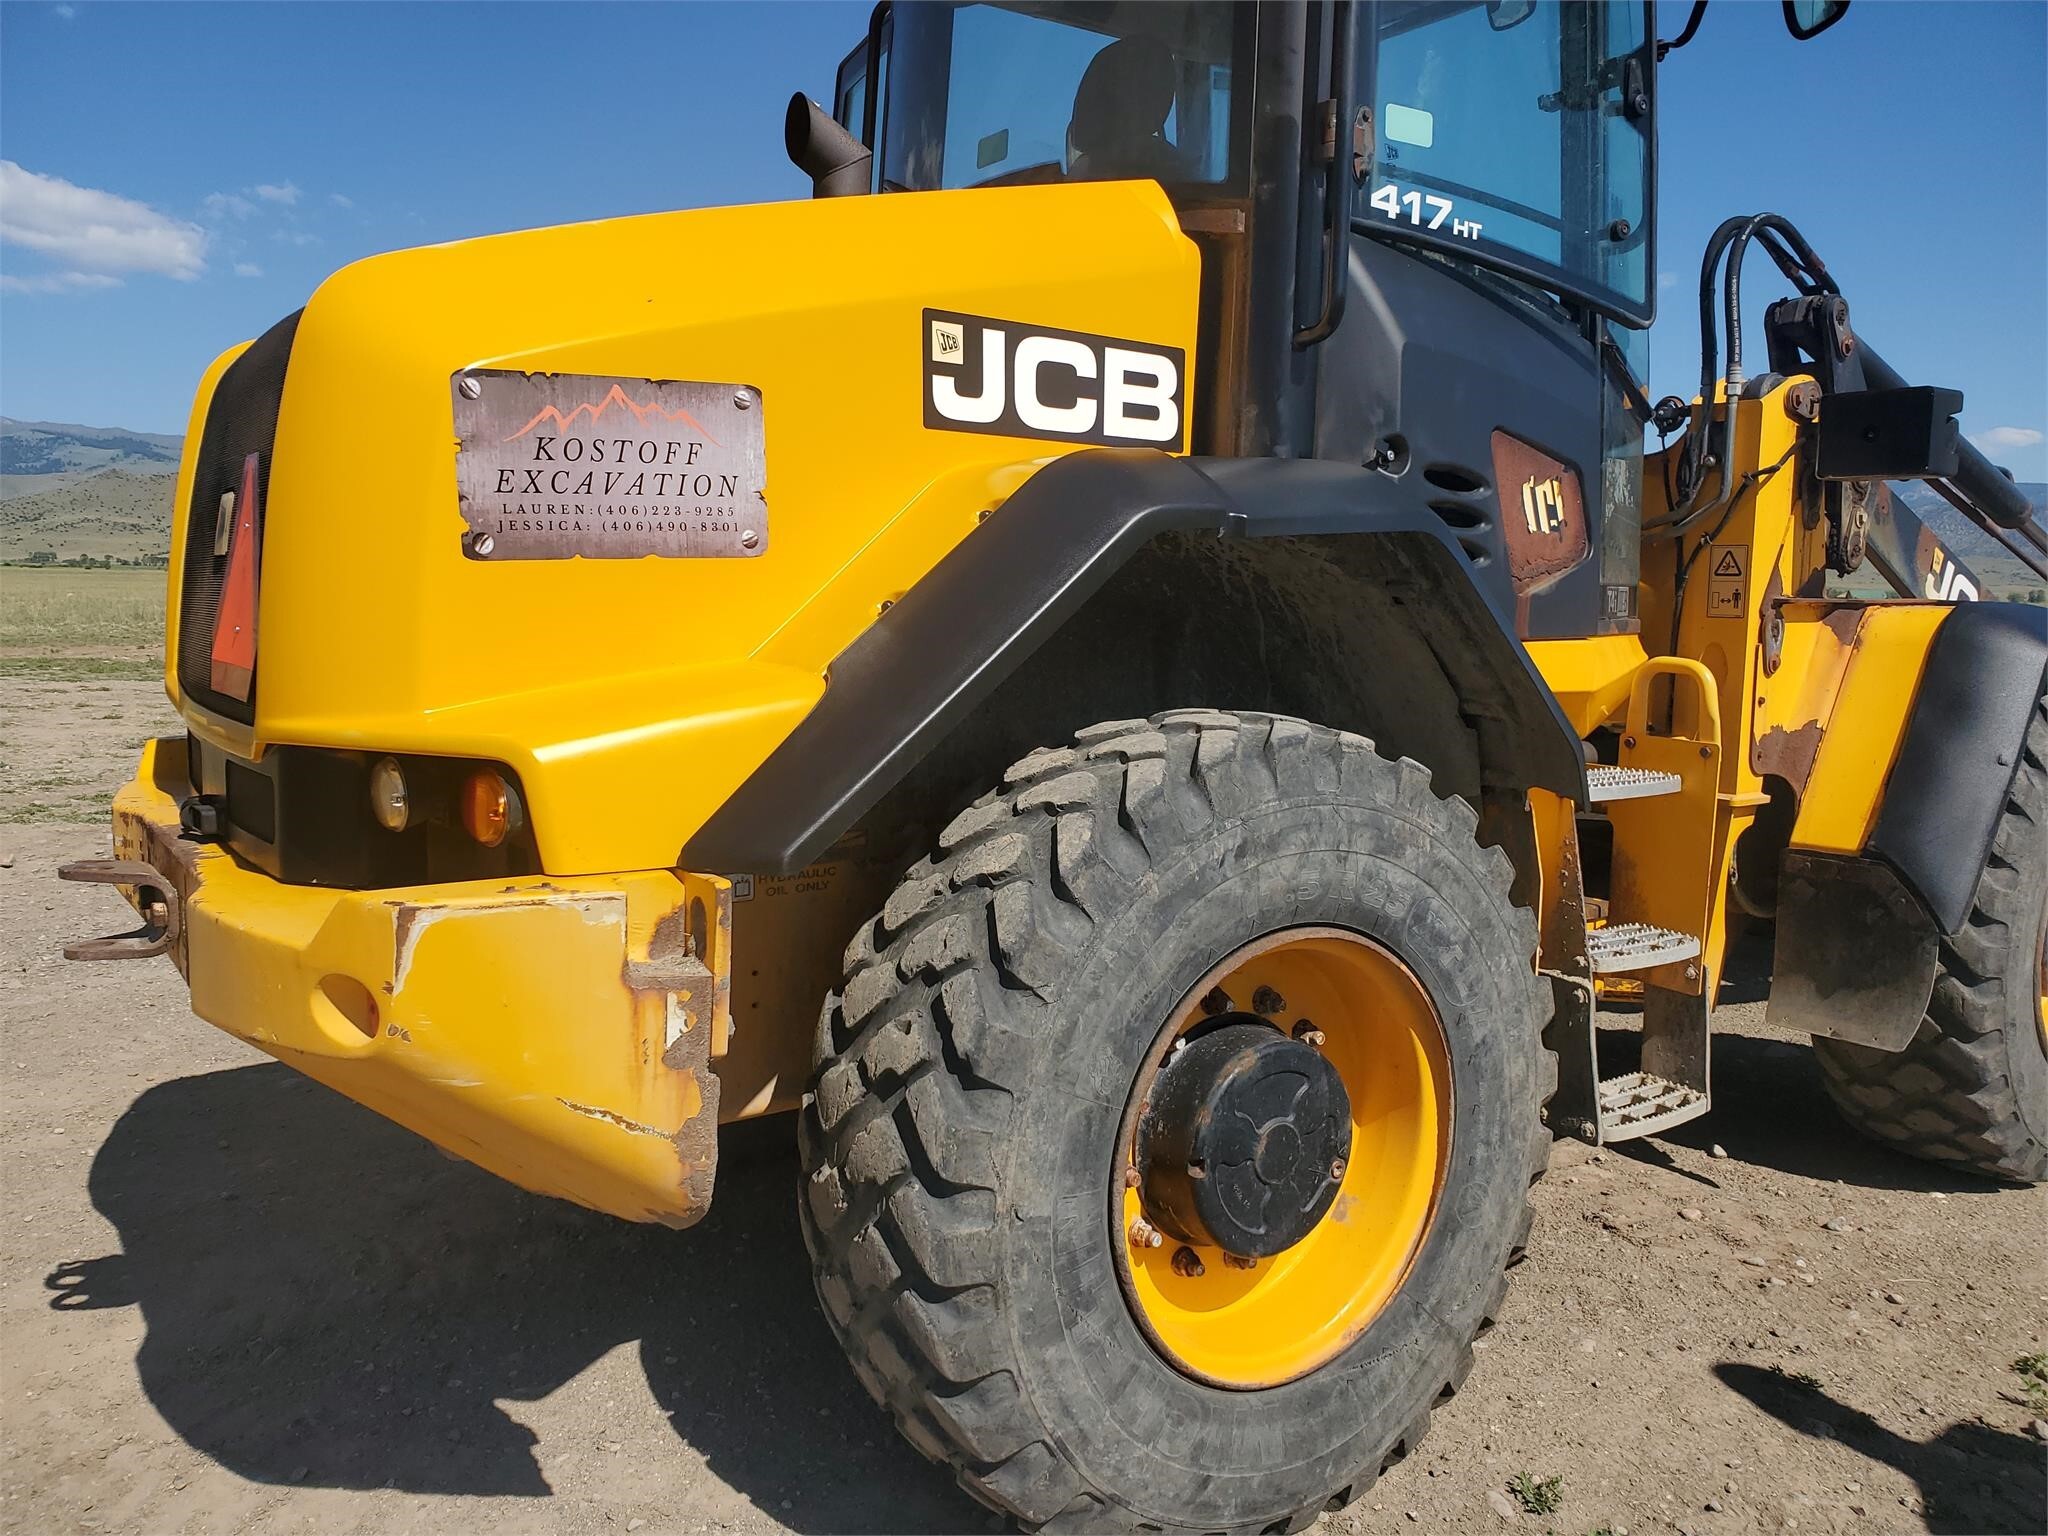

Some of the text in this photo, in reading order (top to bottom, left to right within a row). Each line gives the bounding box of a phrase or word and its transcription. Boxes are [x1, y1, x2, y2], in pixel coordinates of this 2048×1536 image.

[1370, 184, 1483, 240] 417 HT
[940, 332, 958, 351] JCB
[931, 327, 1179, 442] JCB
[533, 436, 703, 466] KOSTOFF
[494, 468, 740, 498] EXCAVATION
[602, 521, 740, 534] (406)490-8301
[766, 879, 830, 897] OIL ONLY
